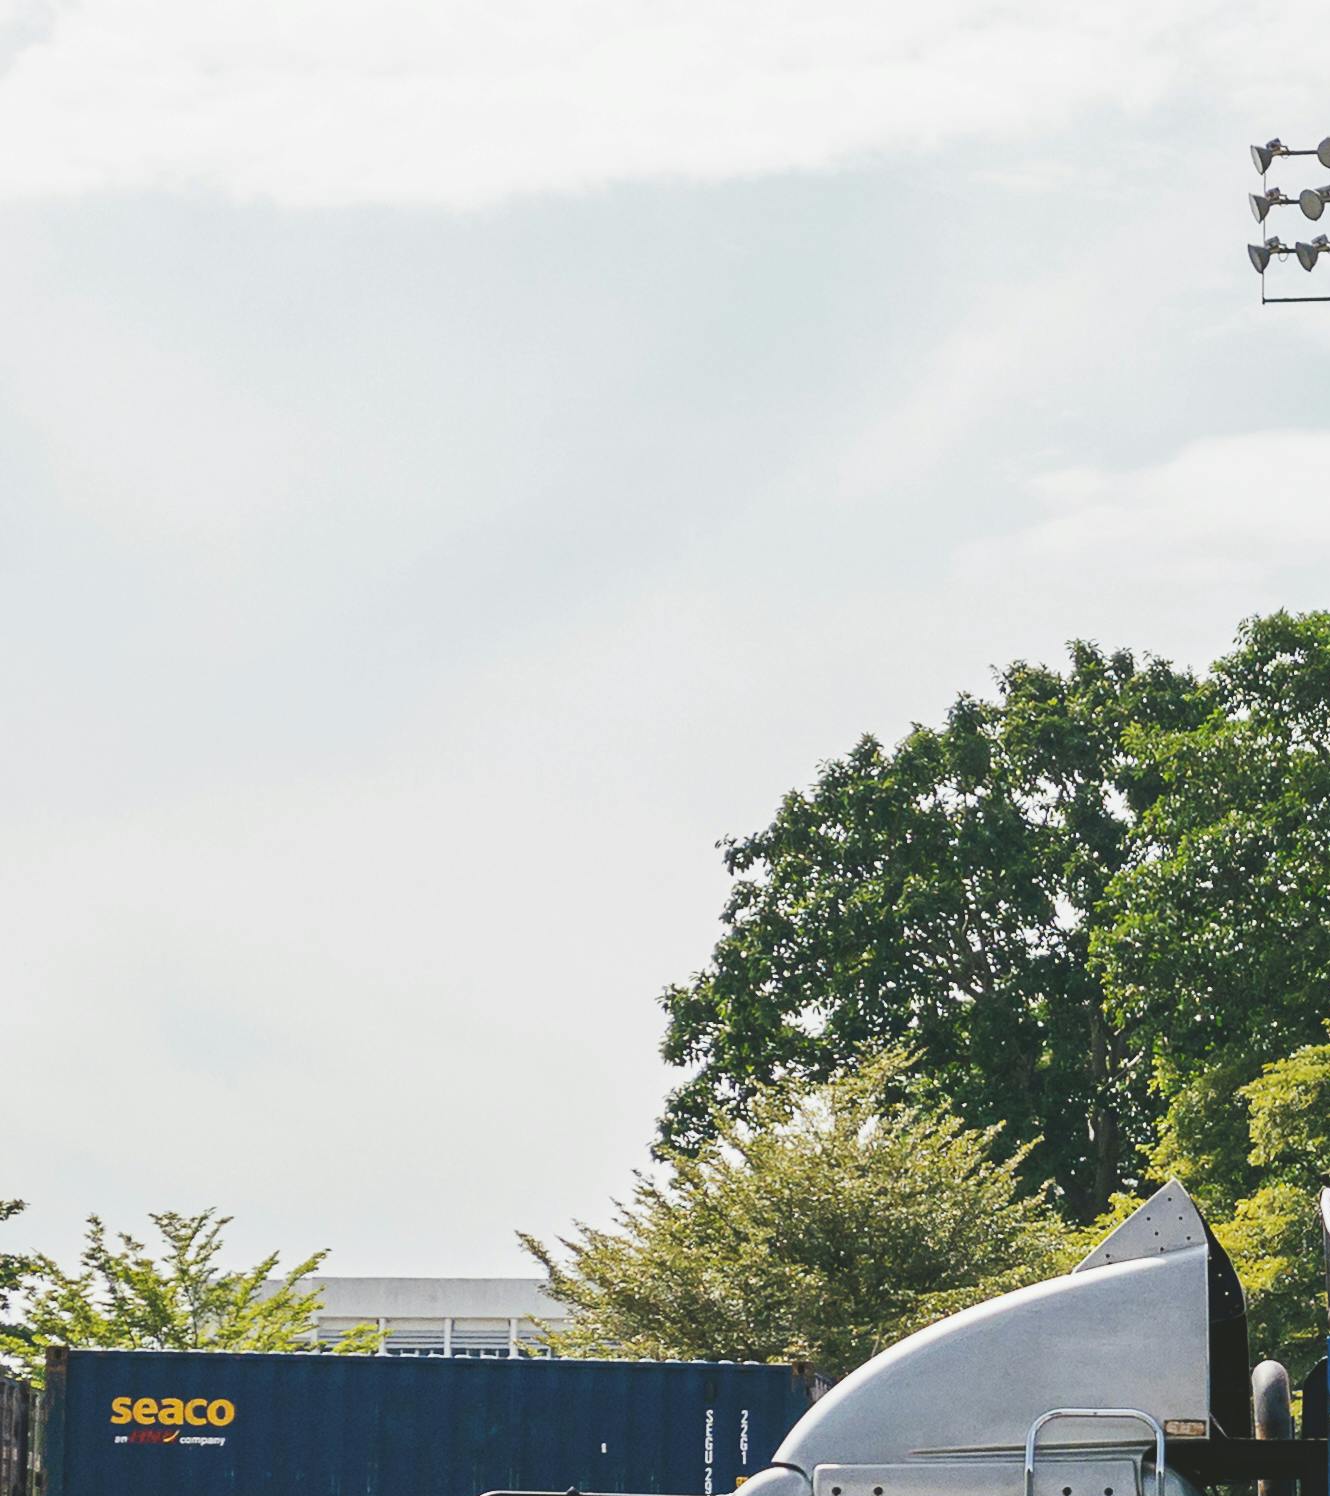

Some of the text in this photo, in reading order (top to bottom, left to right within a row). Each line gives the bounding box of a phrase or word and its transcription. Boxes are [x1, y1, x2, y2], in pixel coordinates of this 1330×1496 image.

[110, 1396, 235, 1426] seaco
[179, 1436, 226, 1447] company
[704, 1409, 714, 1464] SEGU
[740, 1409, 749, 1465] 22G1
